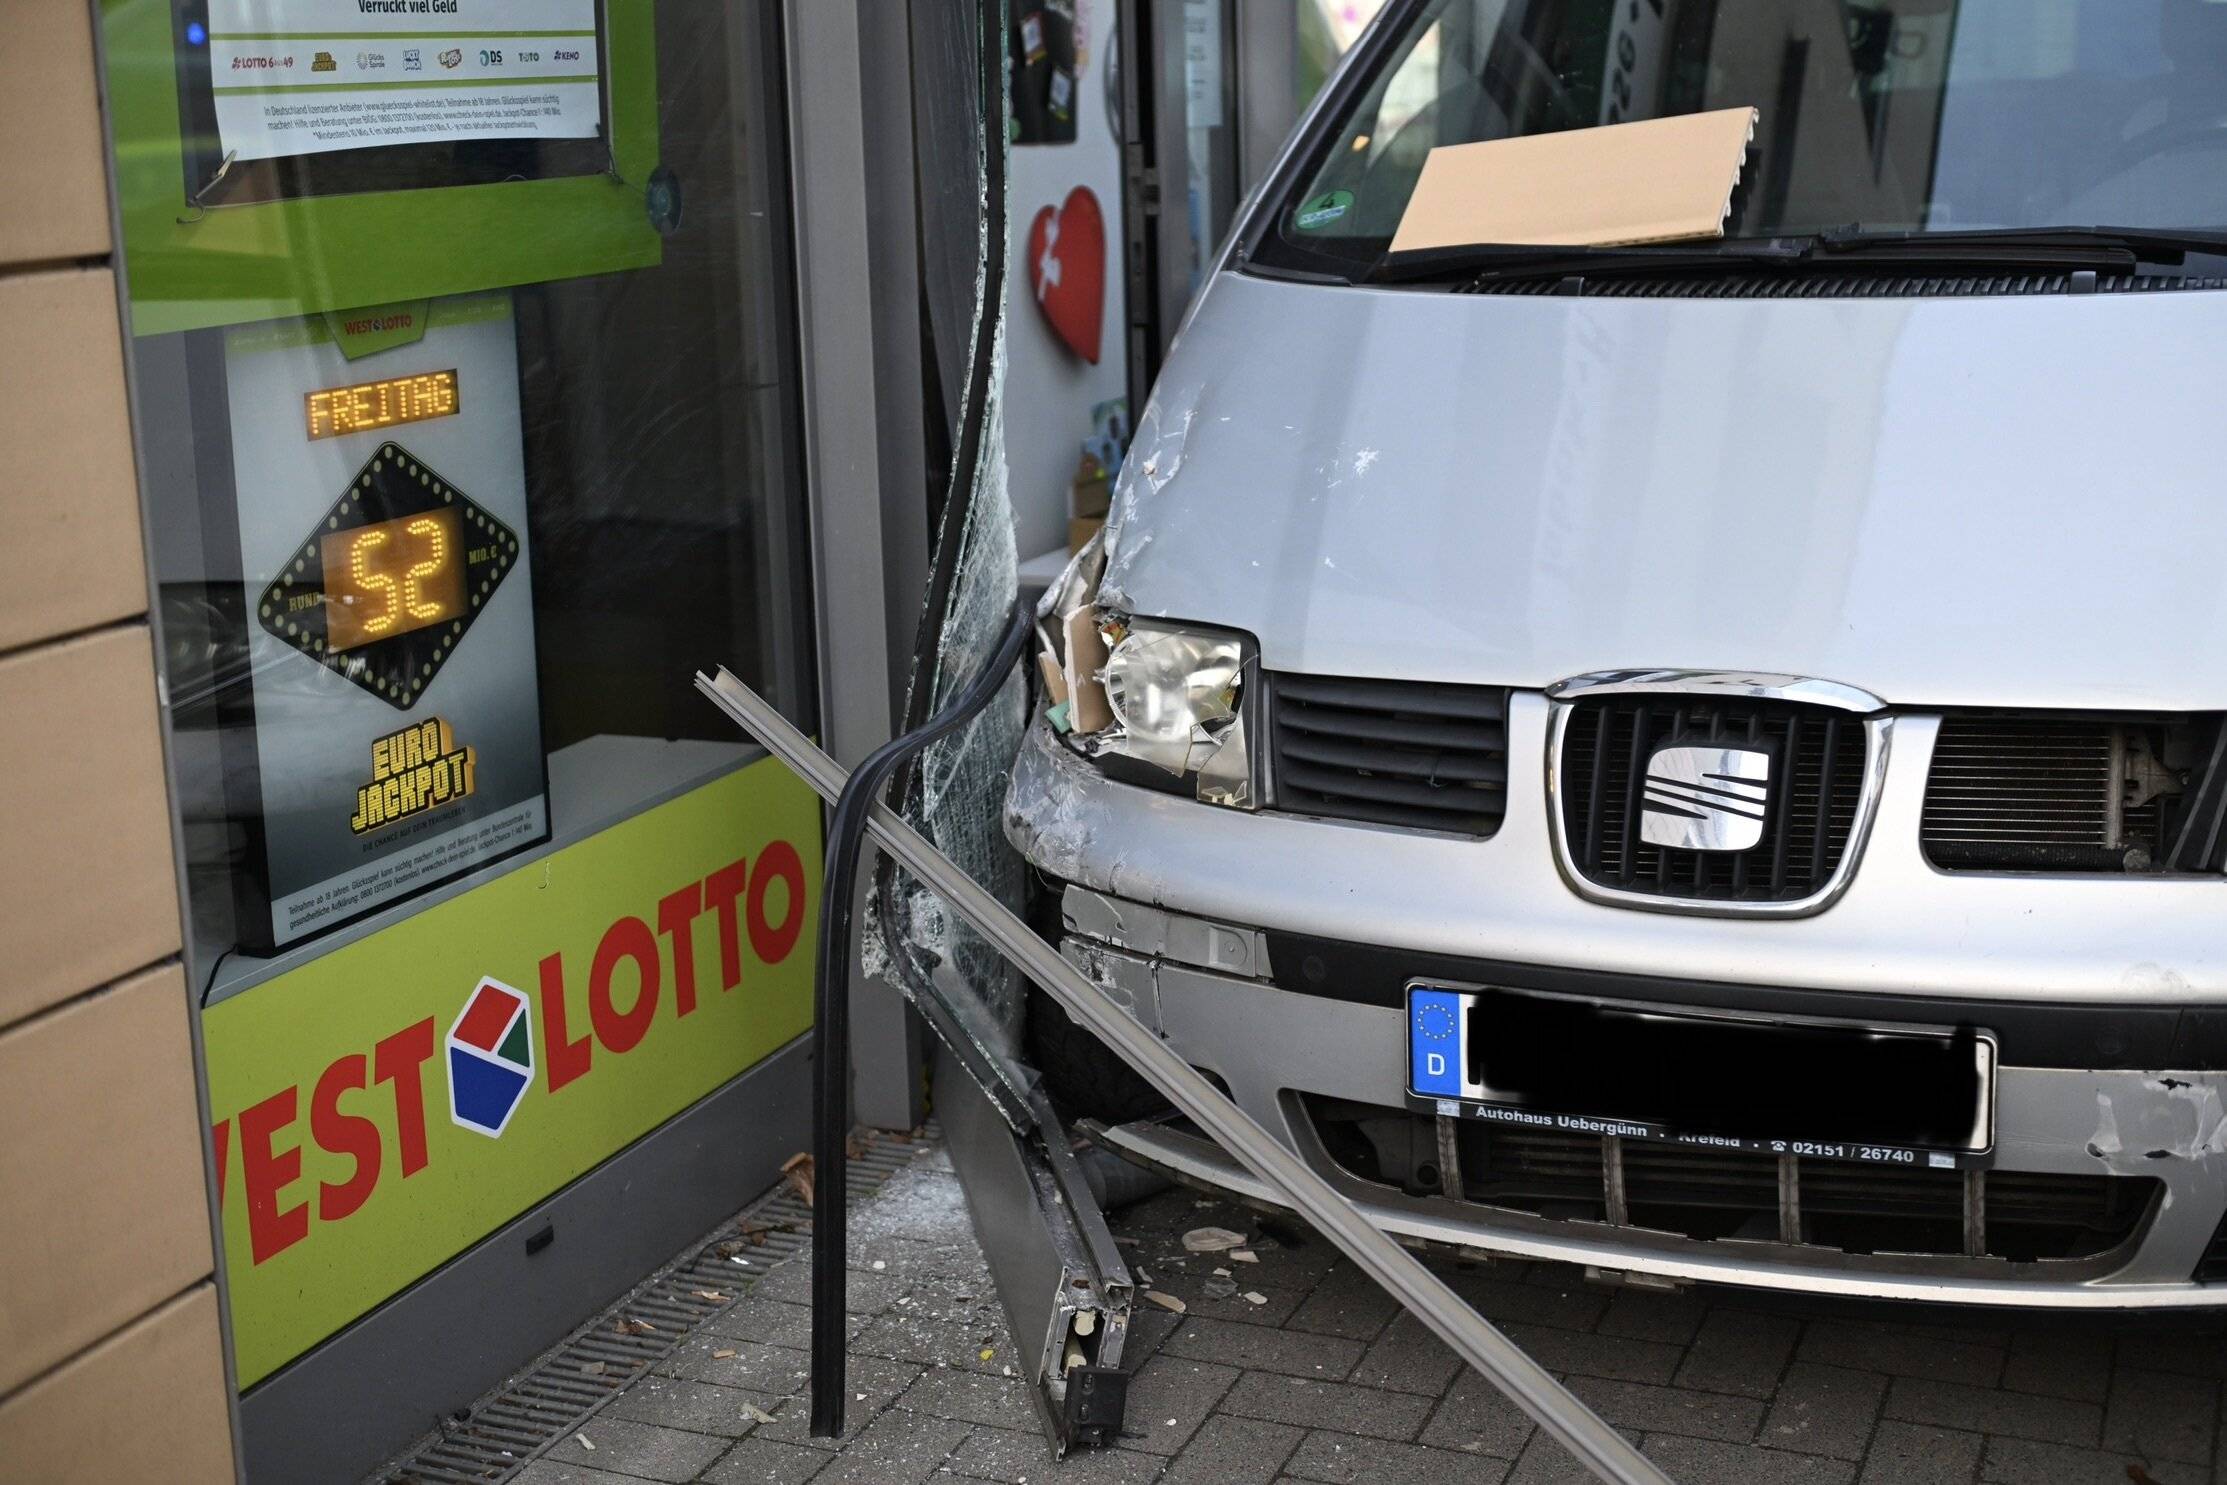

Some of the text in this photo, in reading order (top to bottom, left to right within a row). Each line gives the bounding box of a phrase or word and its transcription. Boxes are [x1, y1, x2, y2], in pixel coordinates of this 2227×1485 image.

[432, 0, 457, 13] Geld
[242, 57, 267, 69] LOTTO
[283, 56, 294, 68] 49
[490, 50, 503, 63] DS
[561, 50, 580, 61] KENO
[1318, 192, 1335, 208] 4
[344, 315, 413, 336] WEST LOTTO
[309, 373, 452, 436] FREITAG
[468, 547, 490, 565] MIO.
[351, 518, 444, 633] 52
[372, 720, 440, 782] EURO
[351, 751, 466, 832] JACKPOT
[288, 896, 315, 915] Teilnahme
[538, 840, 805, 1094] LOTTO
[1427, 1053, 1446, 1076] D
[1475, 1105, 1553, 1126] Autohaus
[1557, 1115, 1649, 1137] Uebergünn
[1792, 1141, 1844, 1157] 02151
[1860, 1147, 1915, 1163] 26740
